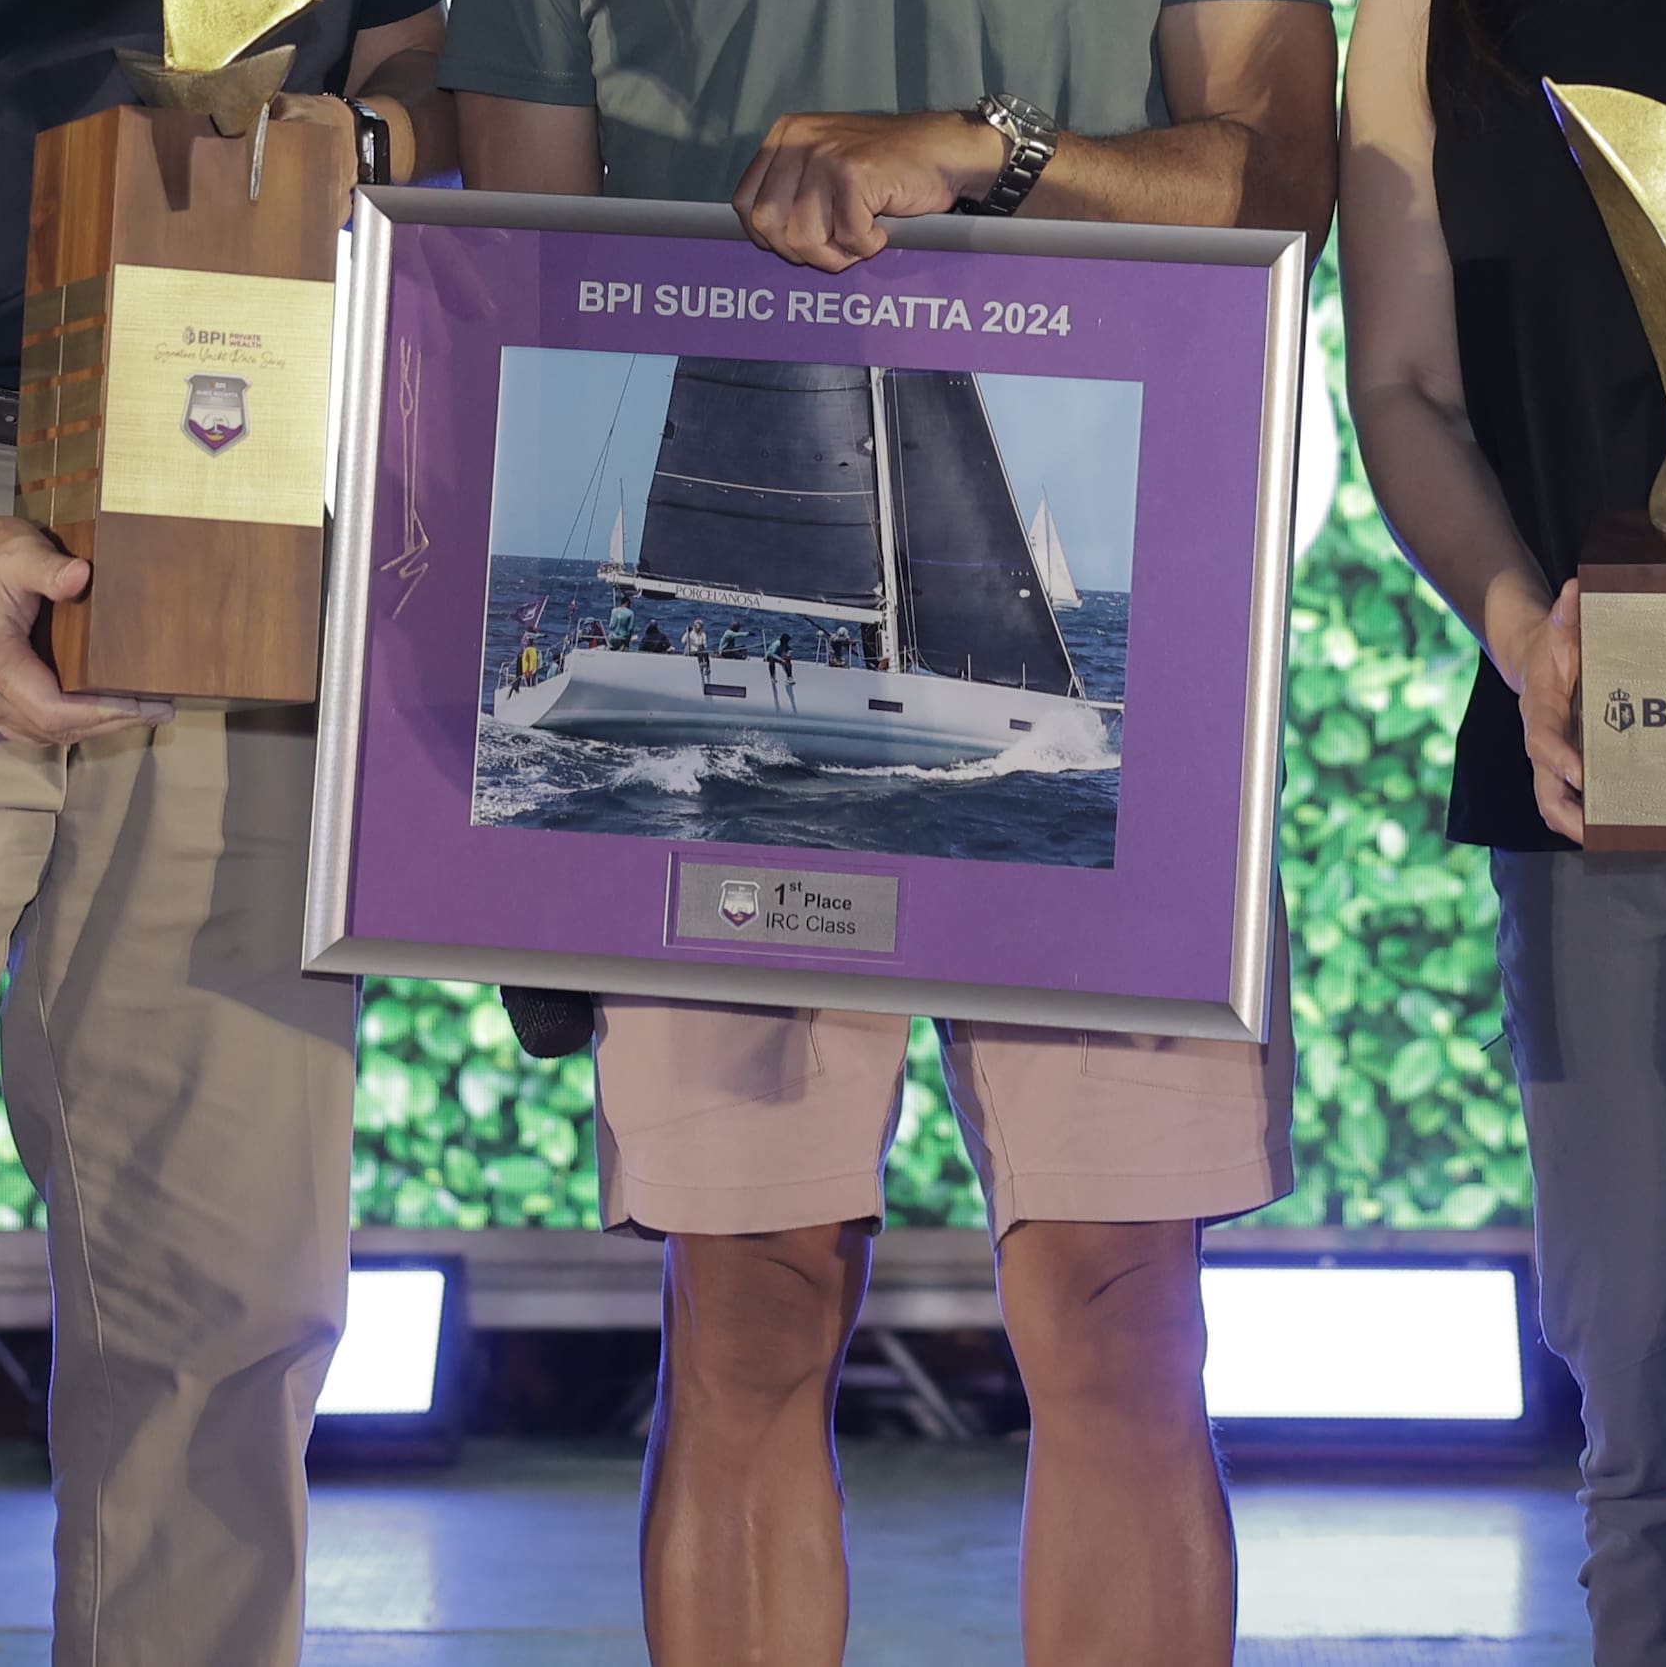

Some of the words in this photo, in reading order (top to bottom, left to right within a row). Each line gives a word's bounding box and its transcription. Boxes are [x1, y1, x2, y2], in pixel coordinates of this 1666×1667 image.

[578, 280, 643, 315] BPI
[654, 284, 775, 321] SUBIC
[787, 290, 972, 332] REGATTA
[981, 300, 1071, 337] 2024
[198, 330, 226, 346] BPI
[229, 332, 262, 342] PRIVATE
[229, 340, 262, 349] WEALTH
[804, 892, 853, 911] Place
[765, 912, 799, 931] IRC
[805, 914, 856, 935] Class
